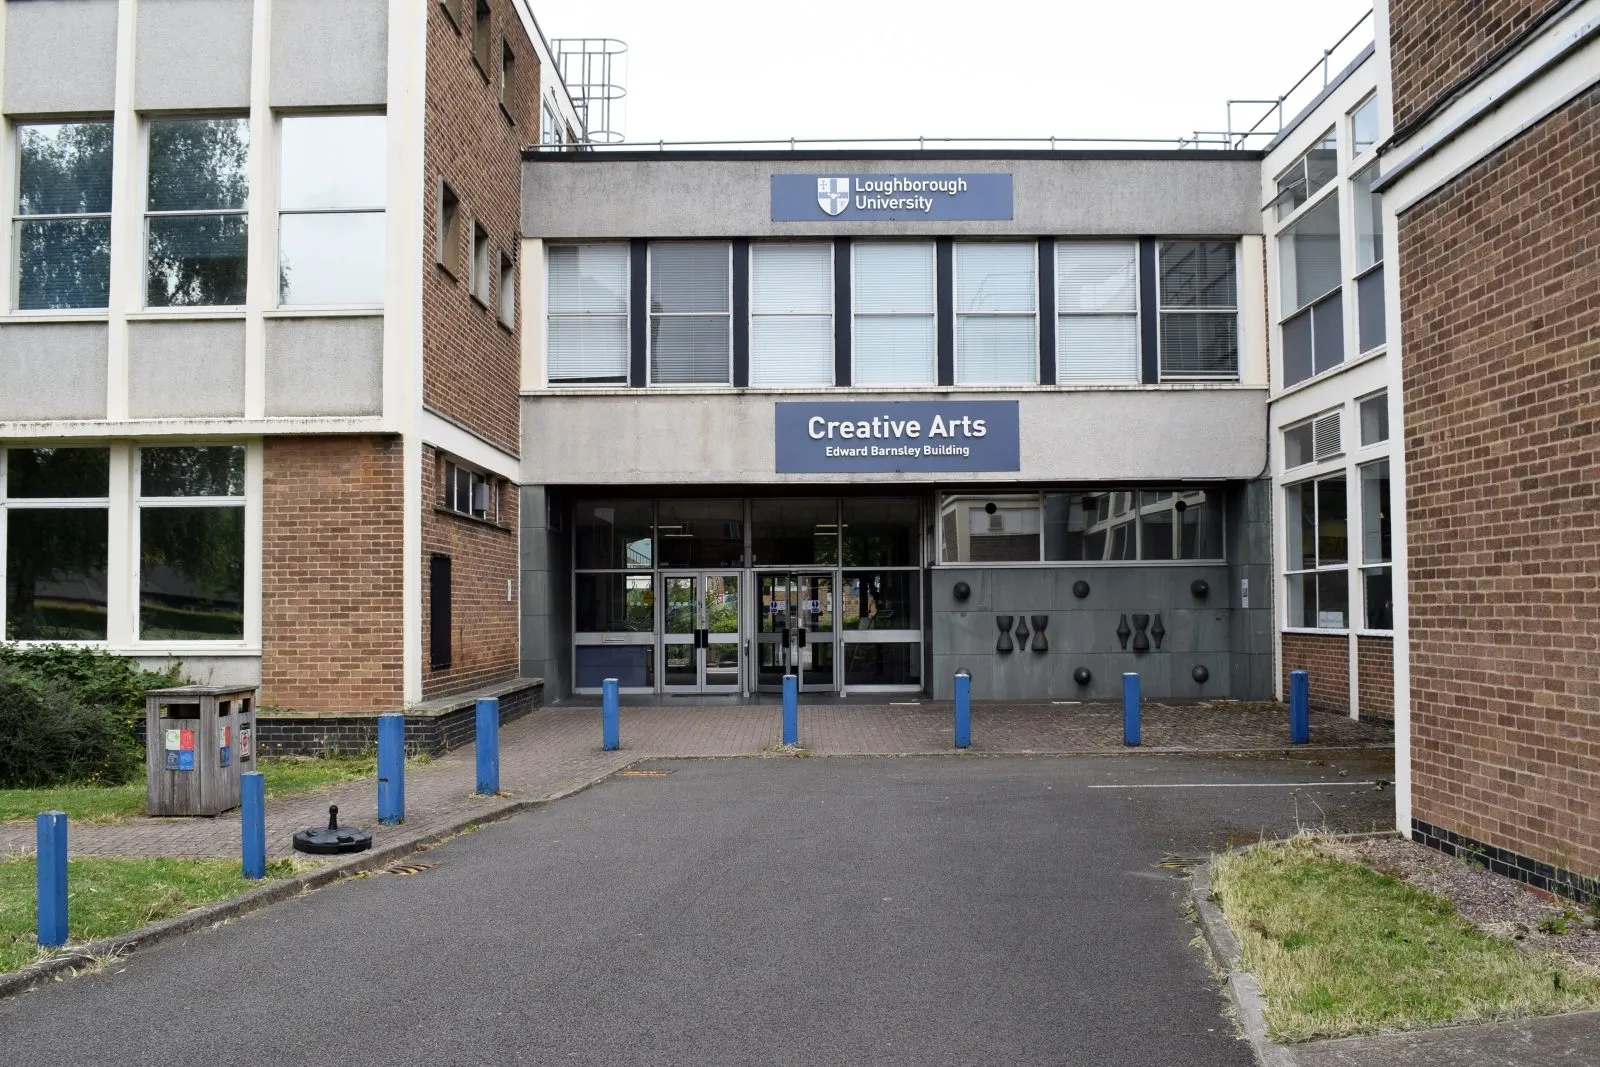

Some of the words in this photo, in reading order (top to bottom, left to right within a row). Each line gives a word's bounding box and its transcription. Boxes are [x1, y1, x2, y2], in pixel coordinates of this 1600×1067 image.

[855, 177, 967, 195] Loughborough
[855, 195, 933, 213] University
[808, 415, 920, 439] Creative
[928, 414, 987, 438] Arts
[826, 446, 868, 457] Edward
[871, 445, 920, 458] Barnsley
[924, 445, 970, 457] Building
